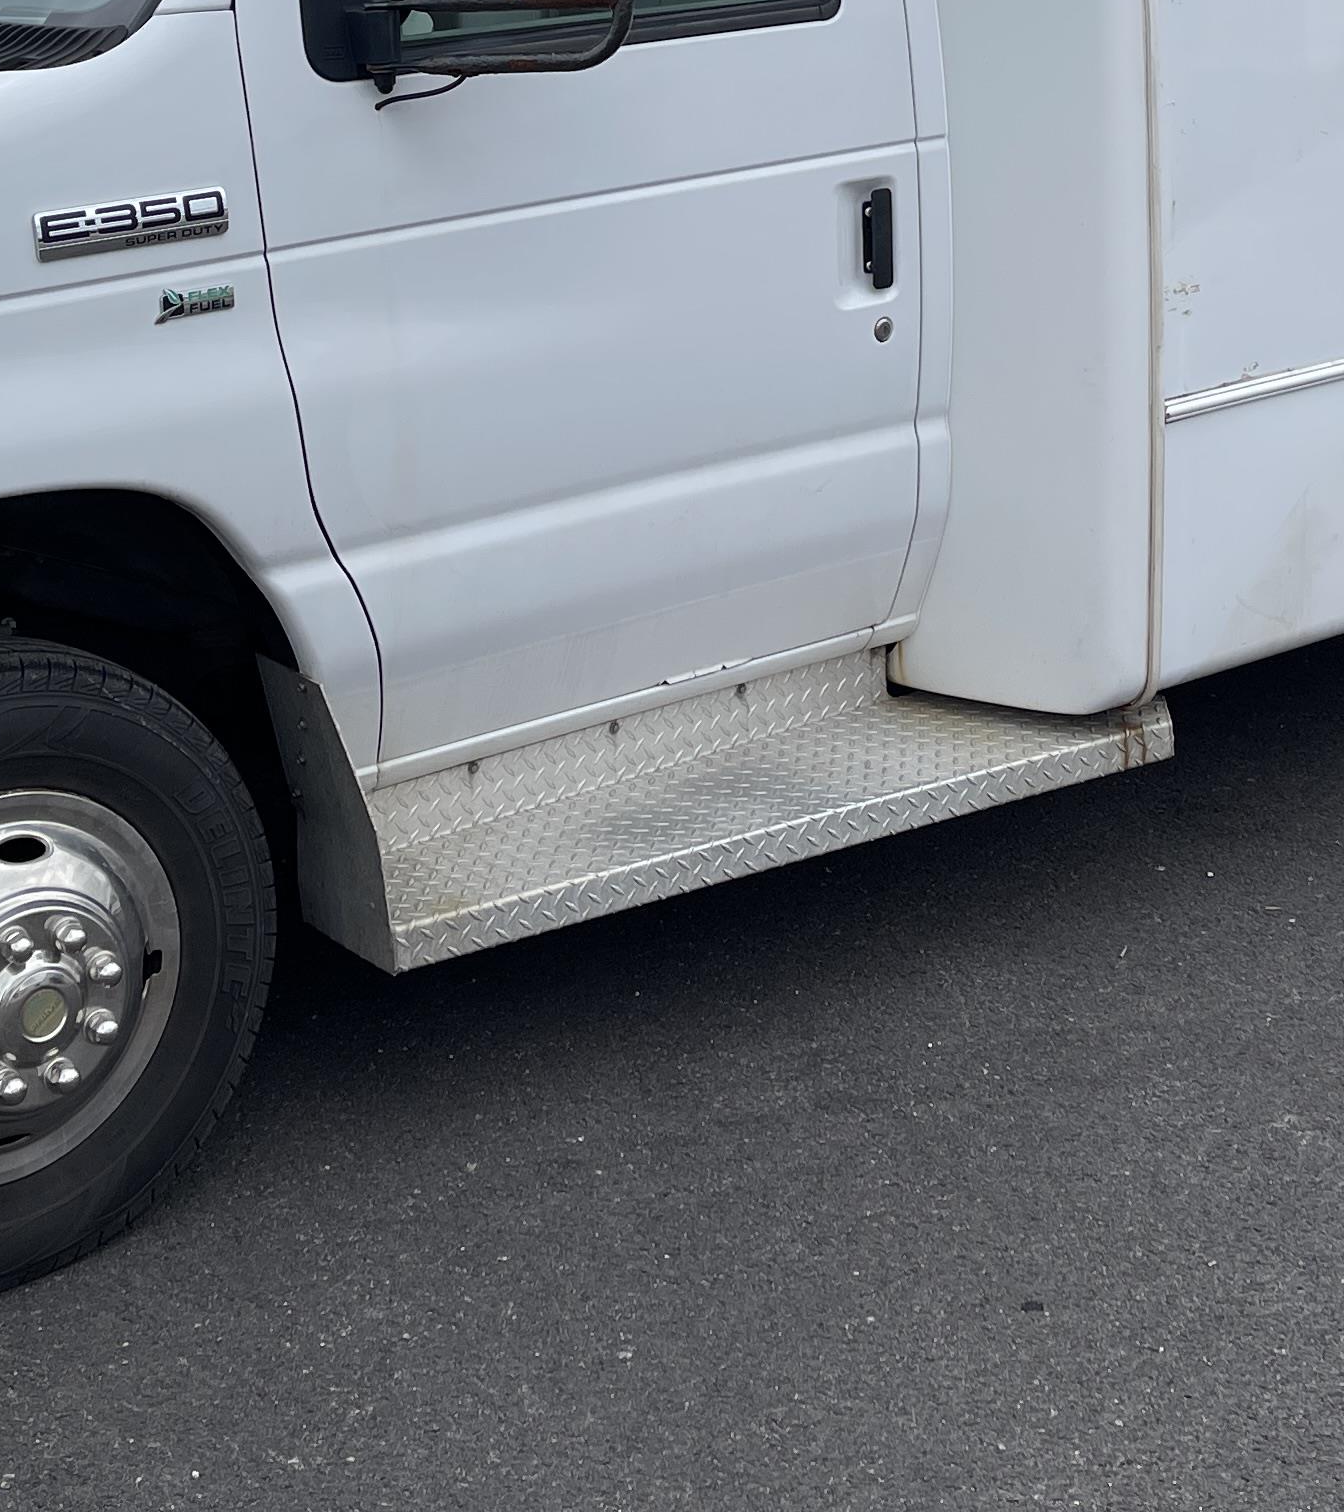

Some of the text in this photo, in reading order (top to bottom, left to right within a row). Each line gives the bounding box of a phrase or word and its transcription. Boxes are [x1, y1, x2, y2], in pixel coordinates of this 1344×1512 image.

[39, 190, 225, 243] E-350
[125, 223, 224, 247] SUPER DUTY
[187, 285, 233, 314] FLEX FUEL
